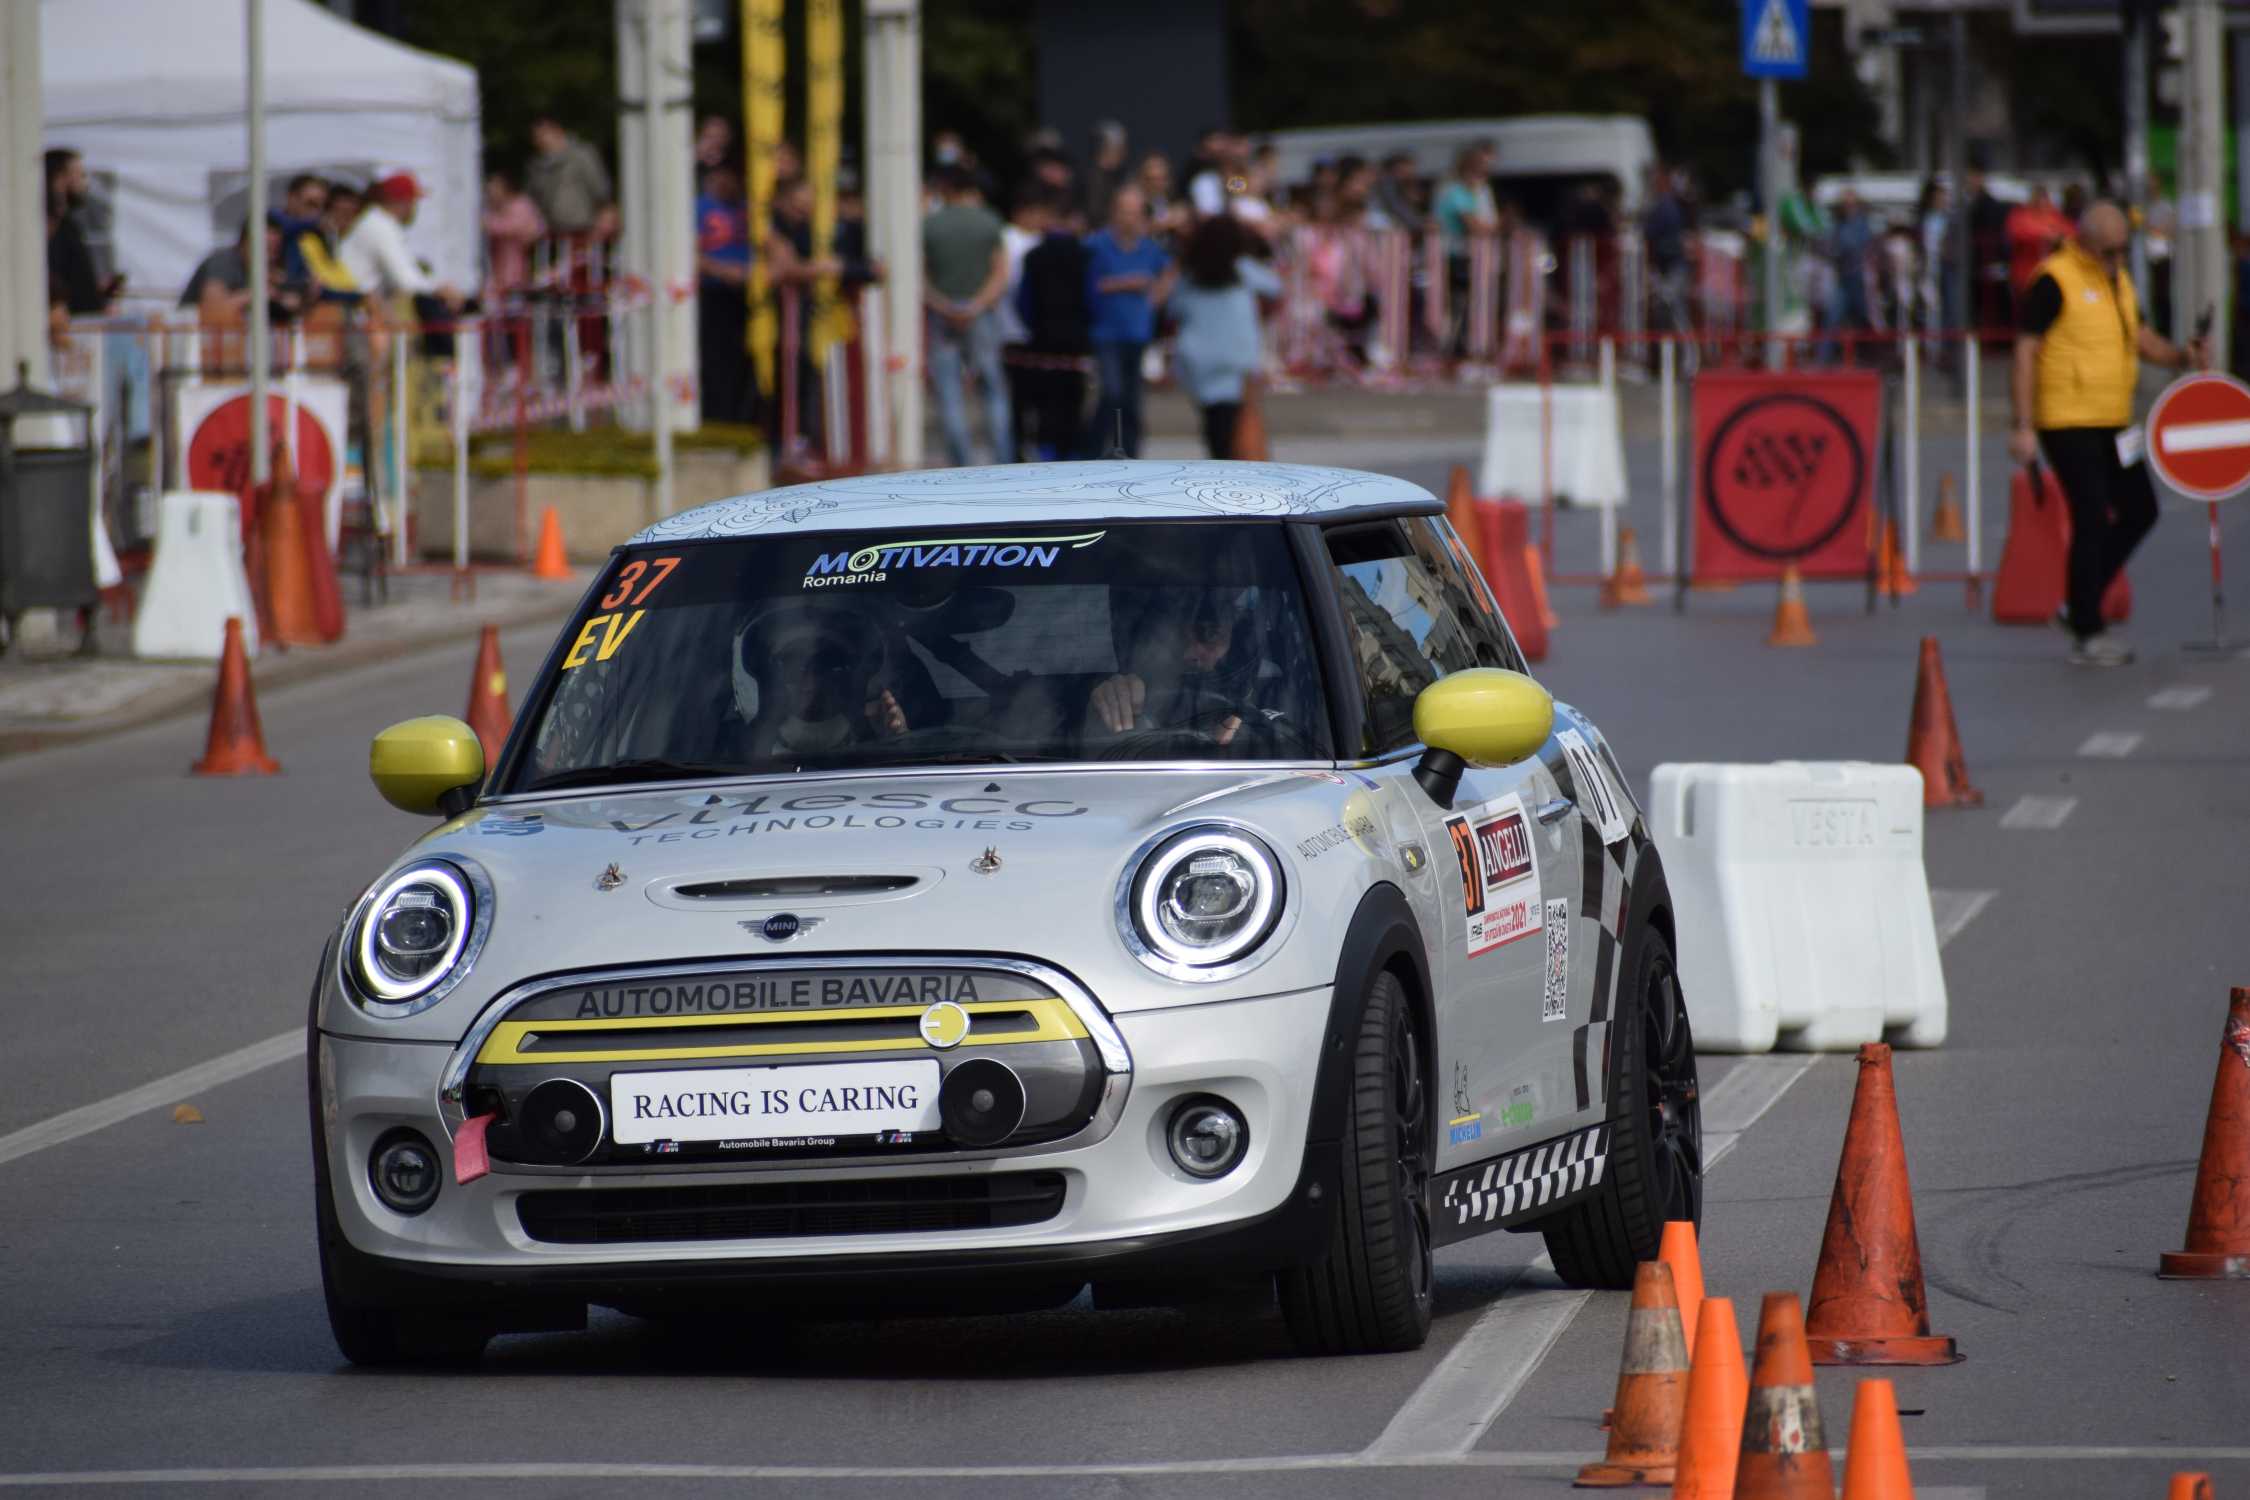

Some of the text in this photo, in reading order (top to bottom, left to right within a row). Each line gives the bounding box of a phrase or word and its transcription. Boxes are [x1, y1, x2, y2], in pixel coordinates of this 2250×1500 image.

[806, 546, 1060, 575] MOTIVATION
[601, 557, 682, 610] 37
[802, 571, 888, 588] Romania
[561, 609, 646, 670] EV
[627, 815, 1035, 846] TECHNOLOGIES
[1482, 823, 1530, 876] ANGELLI
[1450, 822, 1481, 911] 37
[766, 921, 797, 931] MINI
[1511, 901, 1527, 931] 2021
[576, 975, 979, 1018] AUTOMOBILE BAVARIA
[633, 1085, 919, 1119] RACING IS CARING
[719, 1137, 835, 1149] Automobile Bavaria Group
